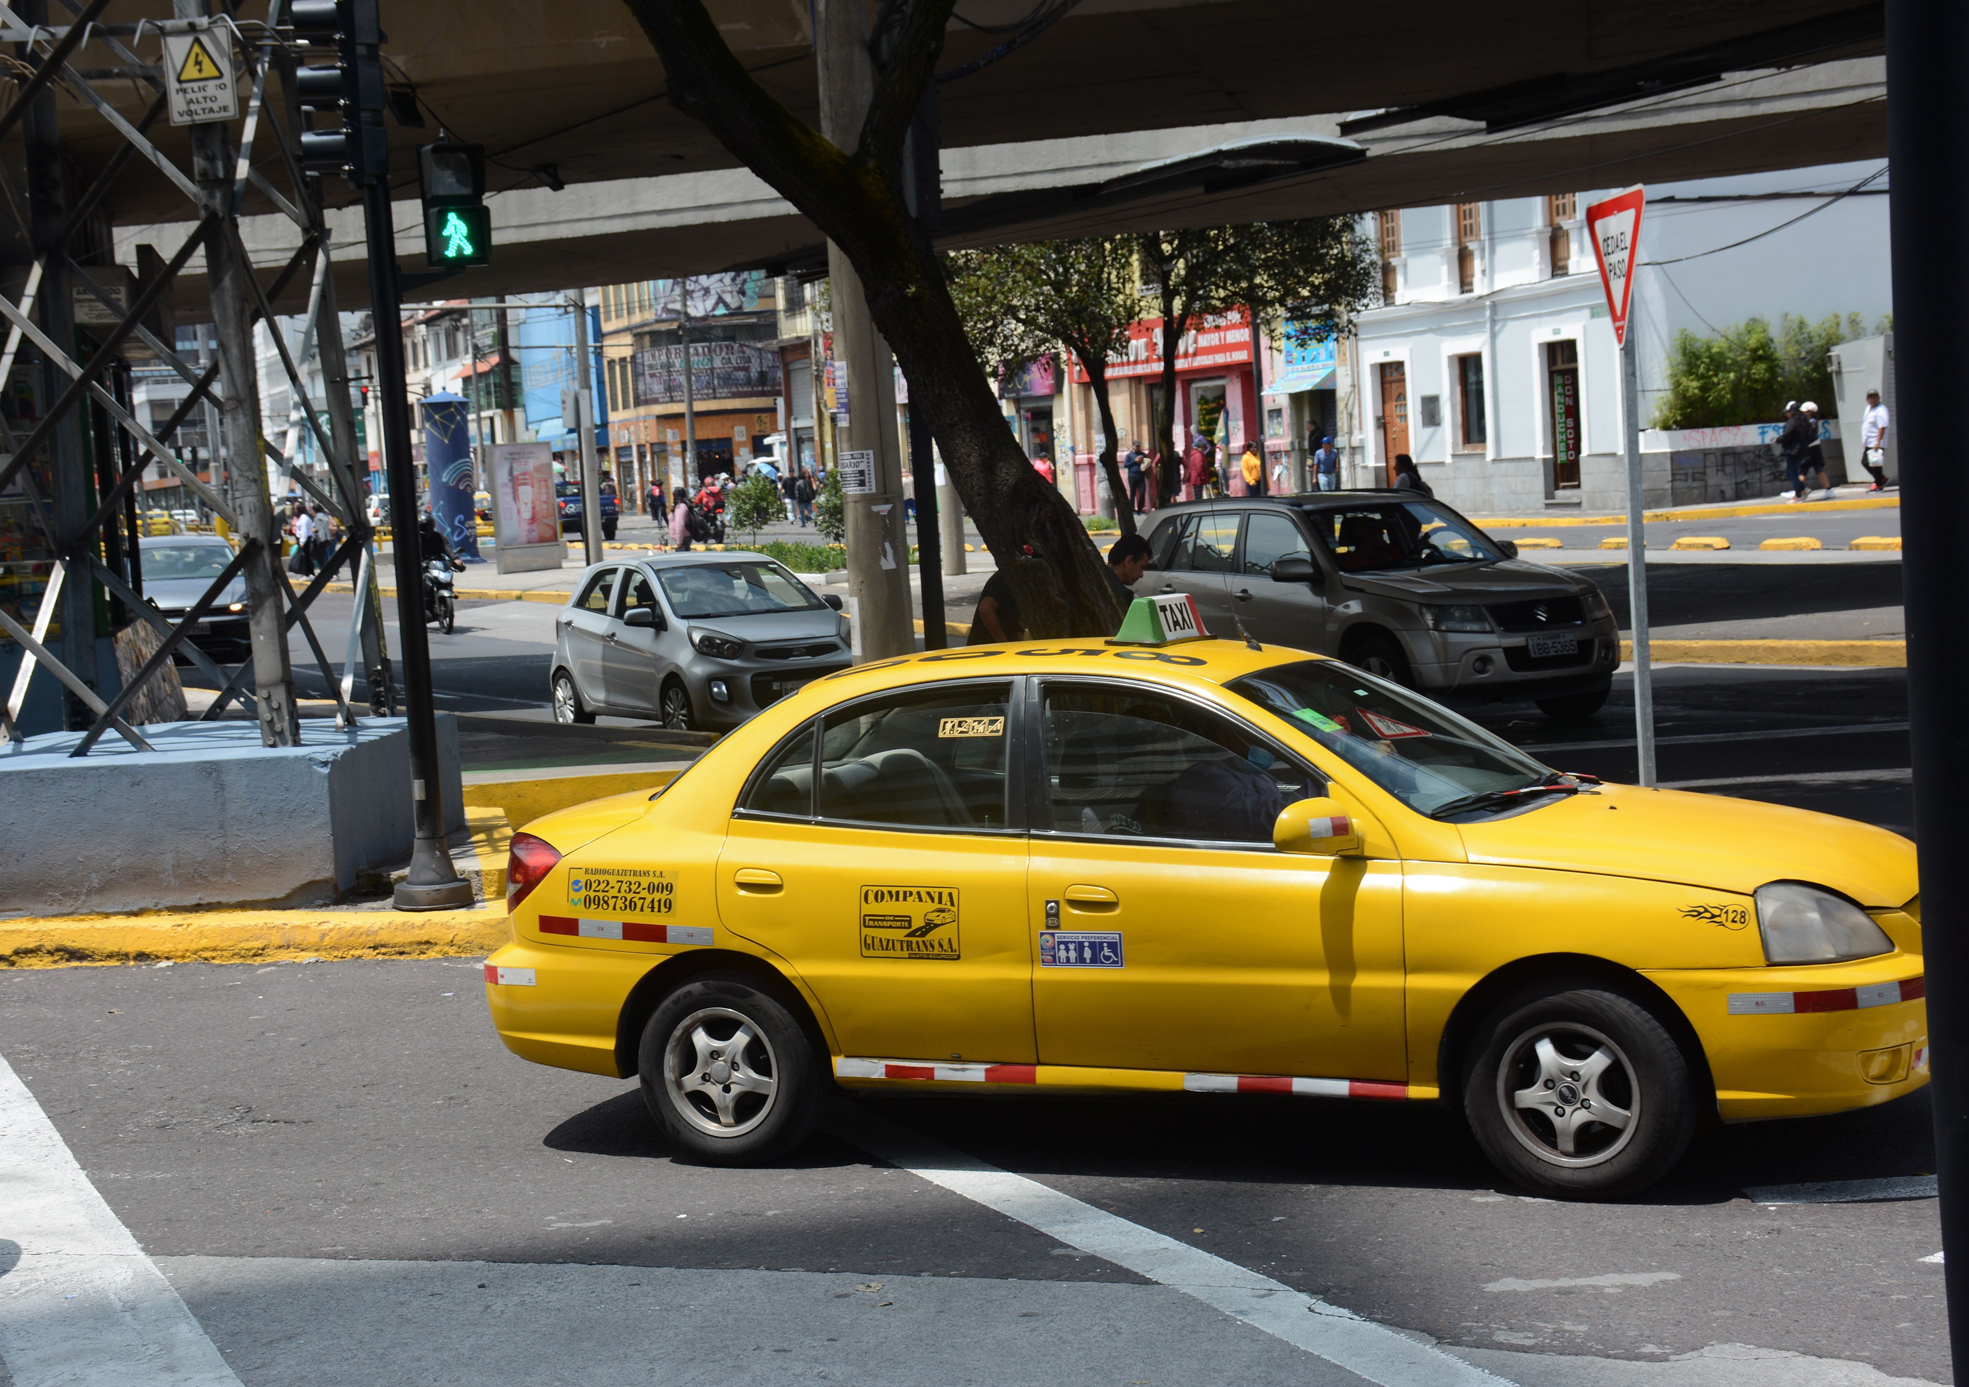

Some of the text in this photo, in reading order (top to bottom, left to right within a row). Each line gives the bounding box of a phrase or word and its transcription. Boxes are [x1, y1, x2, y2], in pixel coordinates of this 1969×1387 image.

[187, 95, 218, 105] ALTO
[177, 105, 230, 117] VOLTAJE
[1603, 231, 1628, 257] CEDA EL
[1608, 259, 1626, 282] PASO
[1198, 332, 1220, 348] MAYOR
[1220, 331, 1225, 345] Y
[1225, 327, 1250, 344] MENOR
[647, 343, 746, 361] IMPORADORA
[1232, 349, 1249, 361] HOGAR
[1556, 375, 1567, 461] SANDUCHES
[1564, 375, 1576, 460] DON SOTO
[1158, 602, 1194, 633] TAXI
[584, 867, 665, 879] RADIOGUAZUTRANS S.A.
[584, 878, 674, 896] 022-732-009
[583, 894, 673, 914] 0987367419
[863, 888, 955, 907] COMPANIA
[864, 916, 910, 927] TRANSPORTE
[1723, 909, 1747, 924] 128
[863, 933, 957, 953] GUAZUTRANS S.A.
